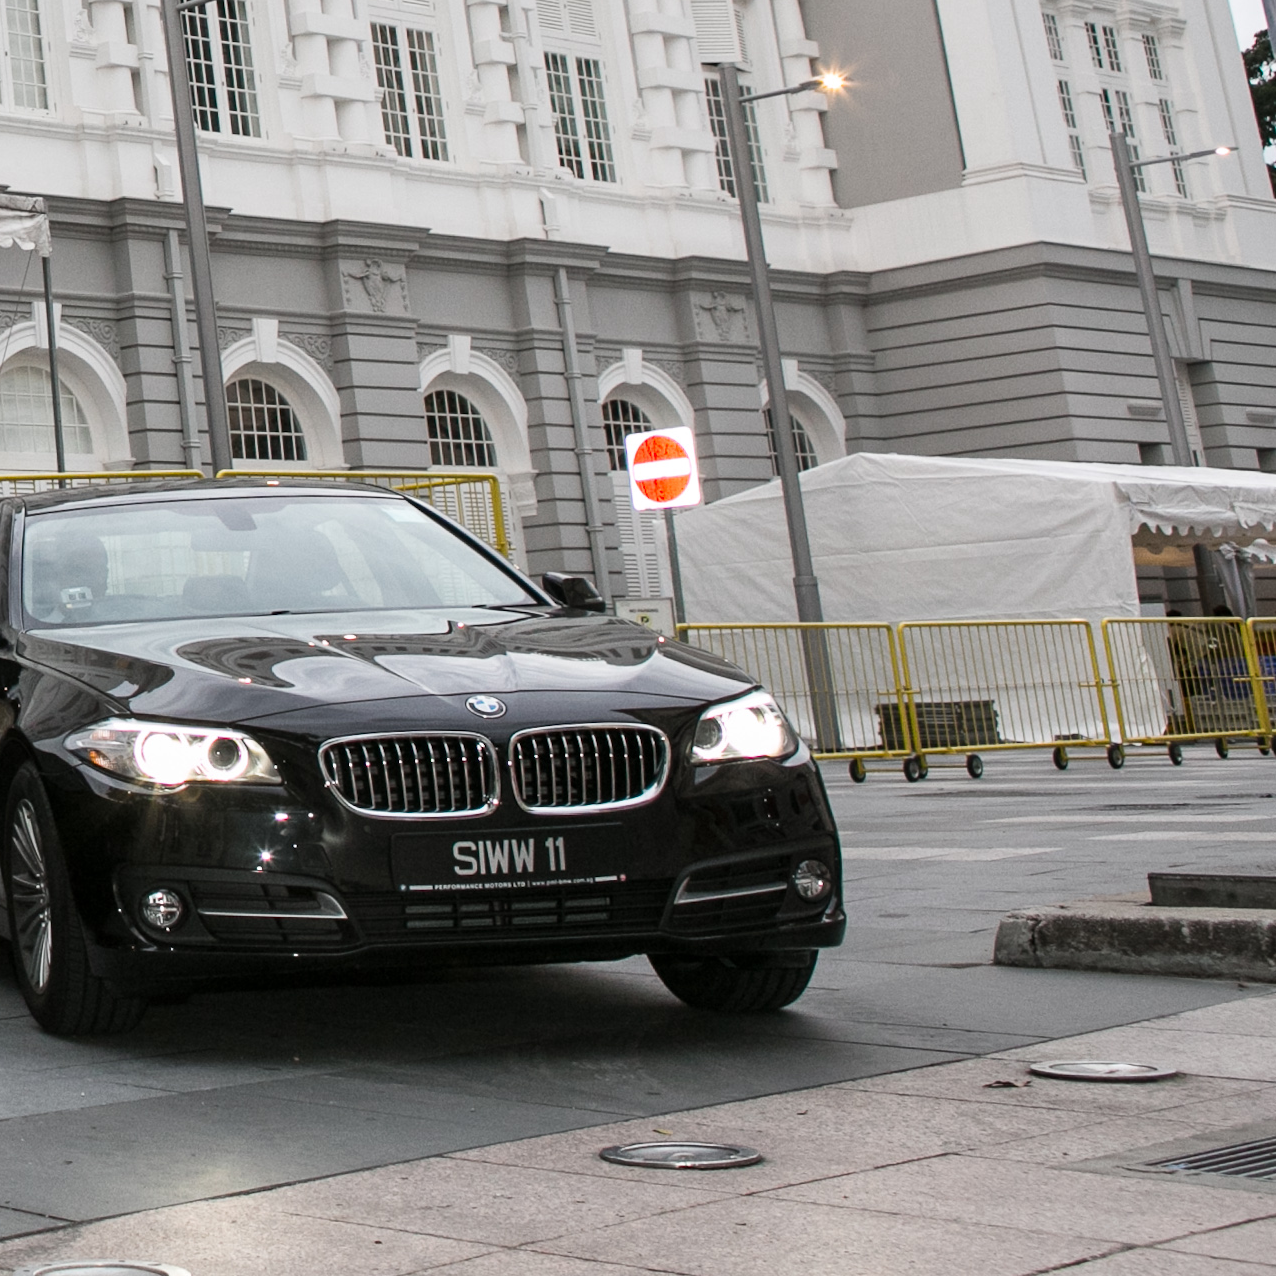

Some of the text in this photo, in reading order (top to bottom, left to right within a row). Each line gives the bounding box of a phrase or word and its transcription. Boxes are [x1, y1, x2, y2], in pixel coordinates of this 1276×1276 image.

[452, 836, 566, 876] SIWW 11
[434, 883, 483, 891] PERFORMANCE
[484, 882, 512, 890] MOTORS
